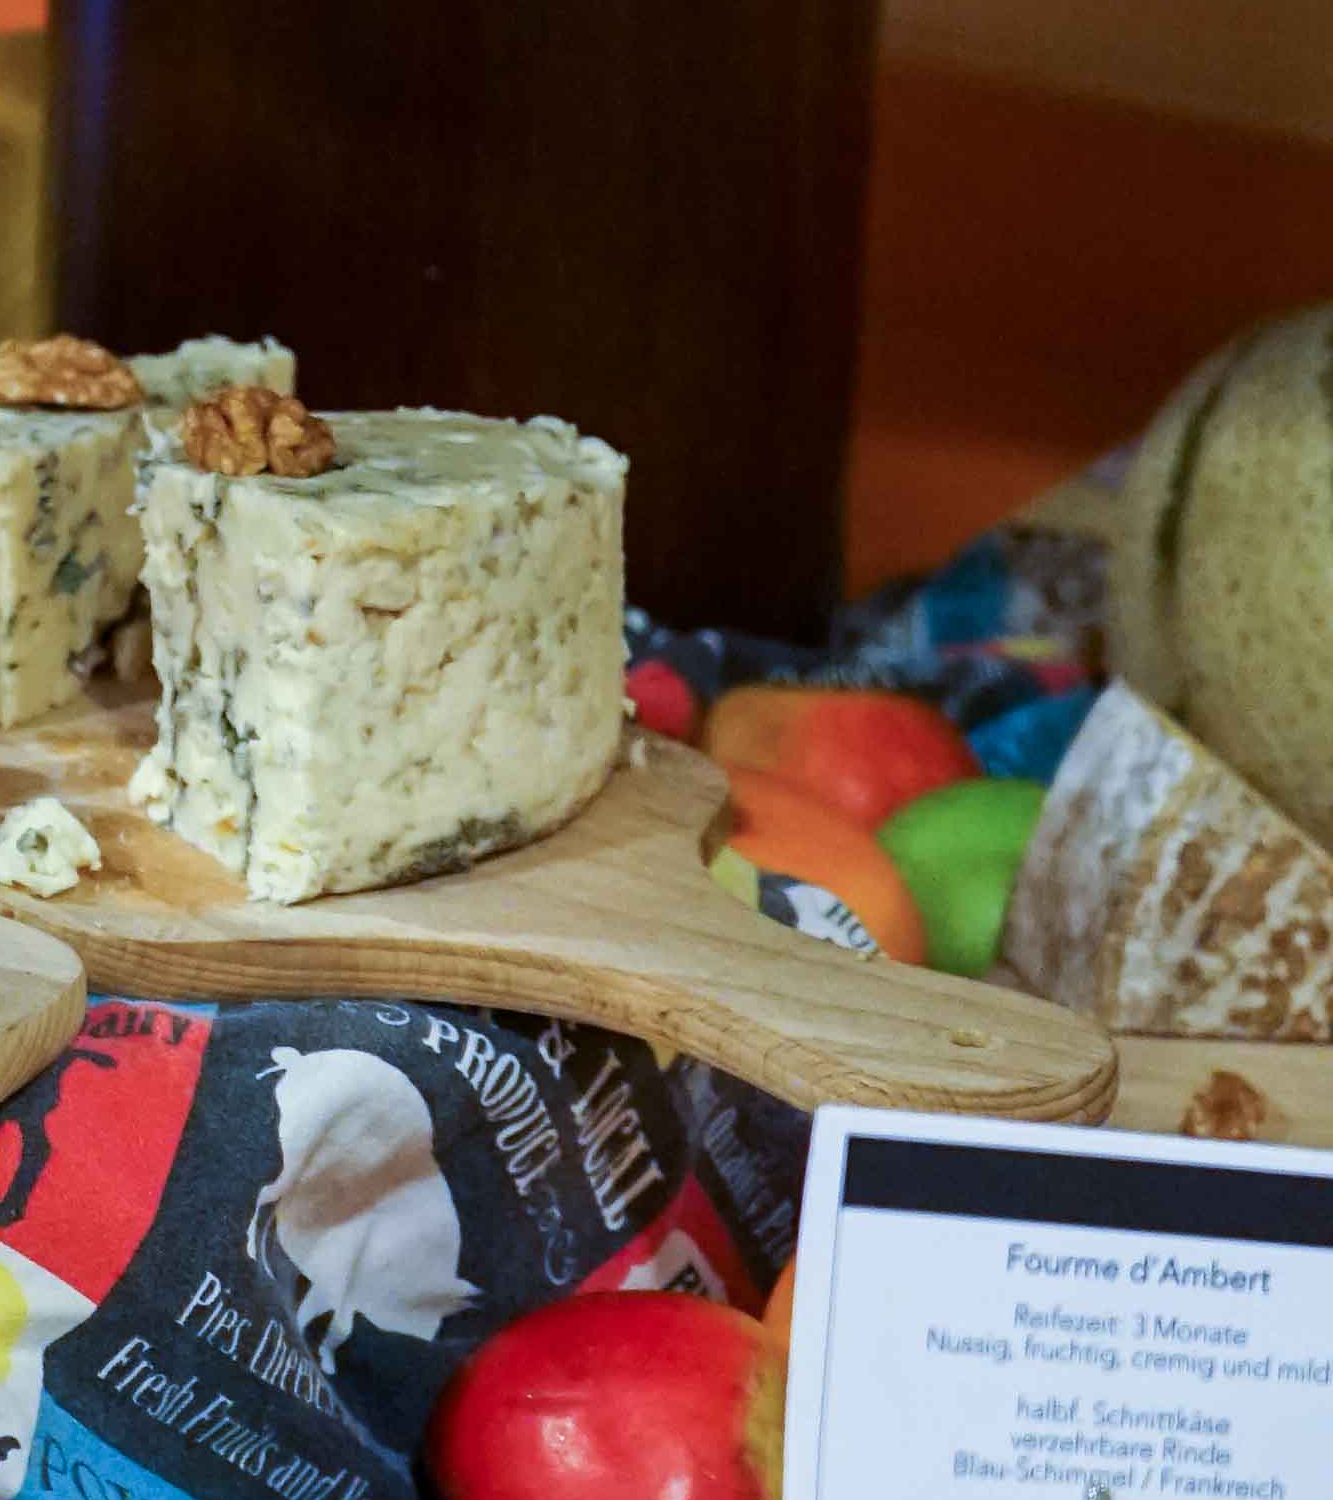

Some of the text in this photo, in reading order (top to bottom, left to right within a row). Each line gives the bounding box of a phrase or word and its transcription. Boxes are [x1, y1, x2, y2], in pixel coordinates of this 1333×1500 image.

[423, 1015, 561, 1196] PRODUCE
[1005, 1242, 1271, 1295] Fourme d'Ambert
[1154, 1316, 1249, 1346] Monate
[1131, 1348, 1215, 1381] cremig
[1223, 1353, 1269, 1379] und
[96, 1334, 198, 1425] Fresh
[180, 1391, 280, 1477] Fruits
[1092, 1400, 1231, 1436] Schnittkäse
[1010, 1430, 1232, 1467] verzehrbare Rinde
